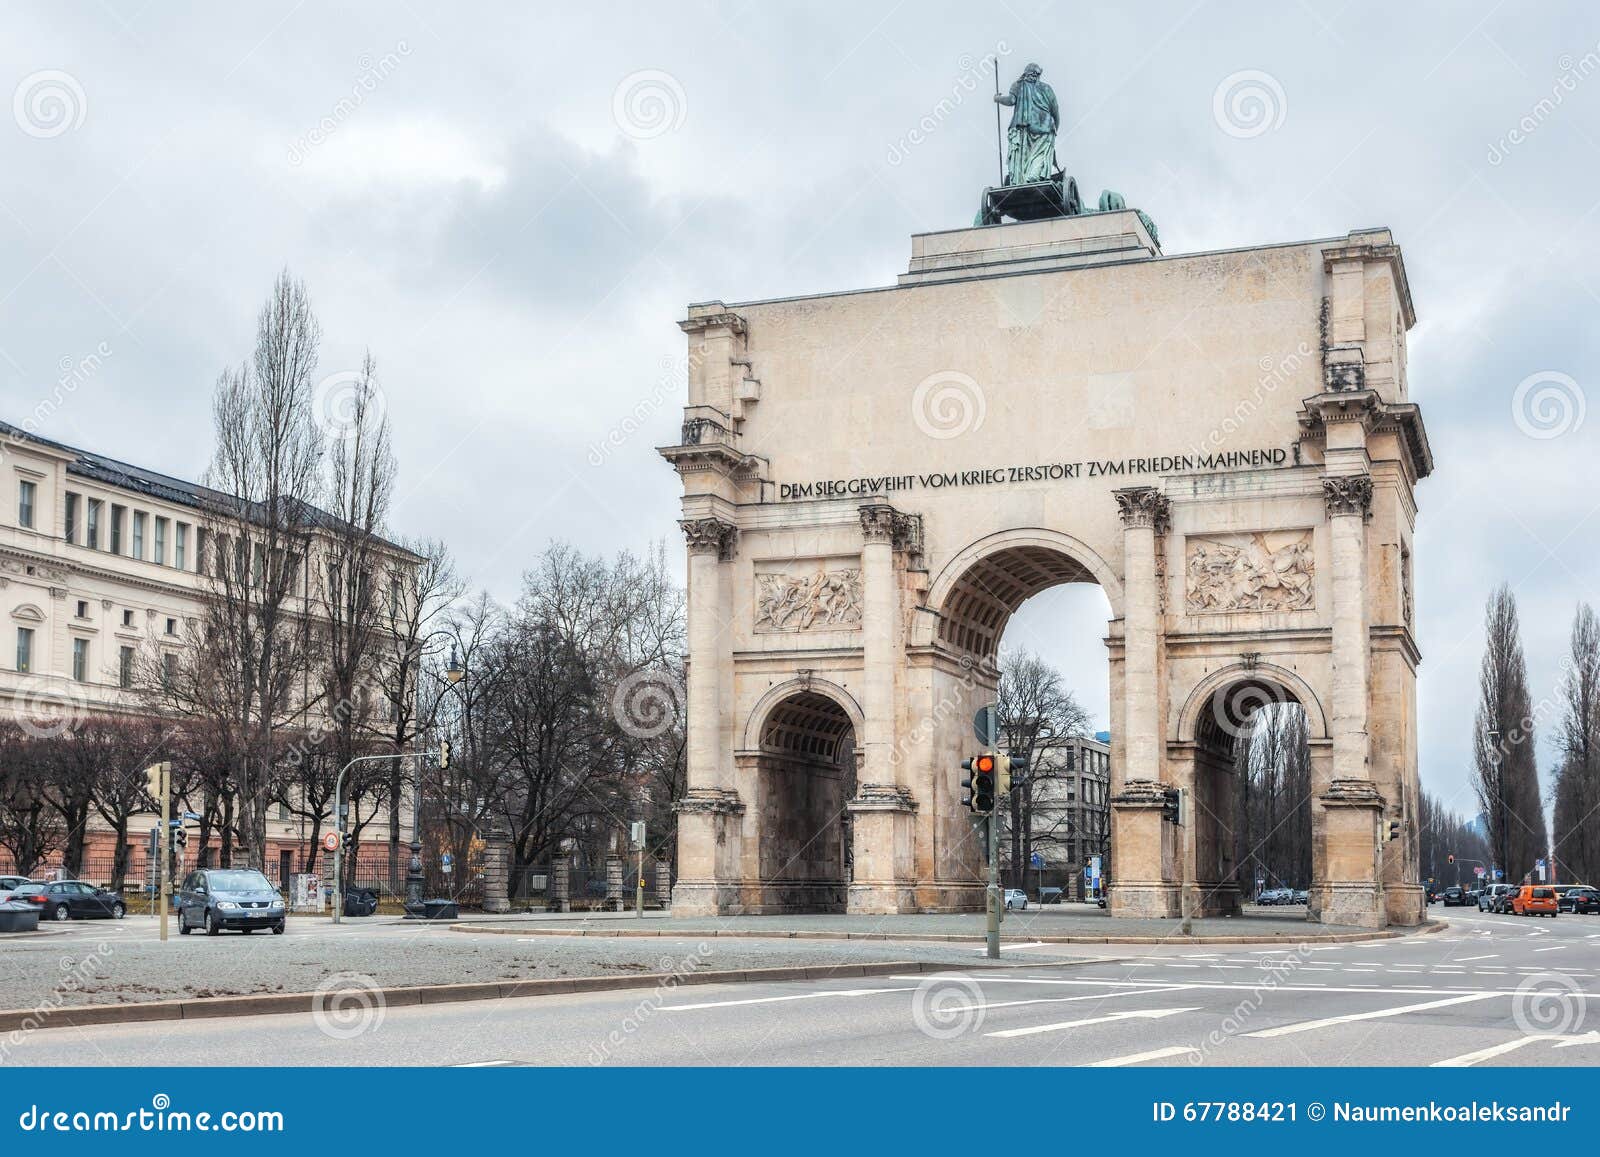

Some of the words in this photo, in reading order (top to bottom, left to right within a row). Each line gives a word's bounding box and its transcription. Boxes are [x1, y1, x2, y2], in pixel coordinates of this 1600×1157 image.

[780, 482, 813, 498] DEM
[815, 480, 846, 497] SIEG
[847, 475, 915, 493] GEWEIHT
[919, 472, 958, 489] VOM
[961, 468, 1006, 486] KRIEG
[1008, 462, 1083, 482] ZERSTÖRT
[1087, 460, 1125, 477] ZVM
[1128, 455, 1193, 474] FRIEDEN
[1197, 448, 1287, 469] MAHNEND
